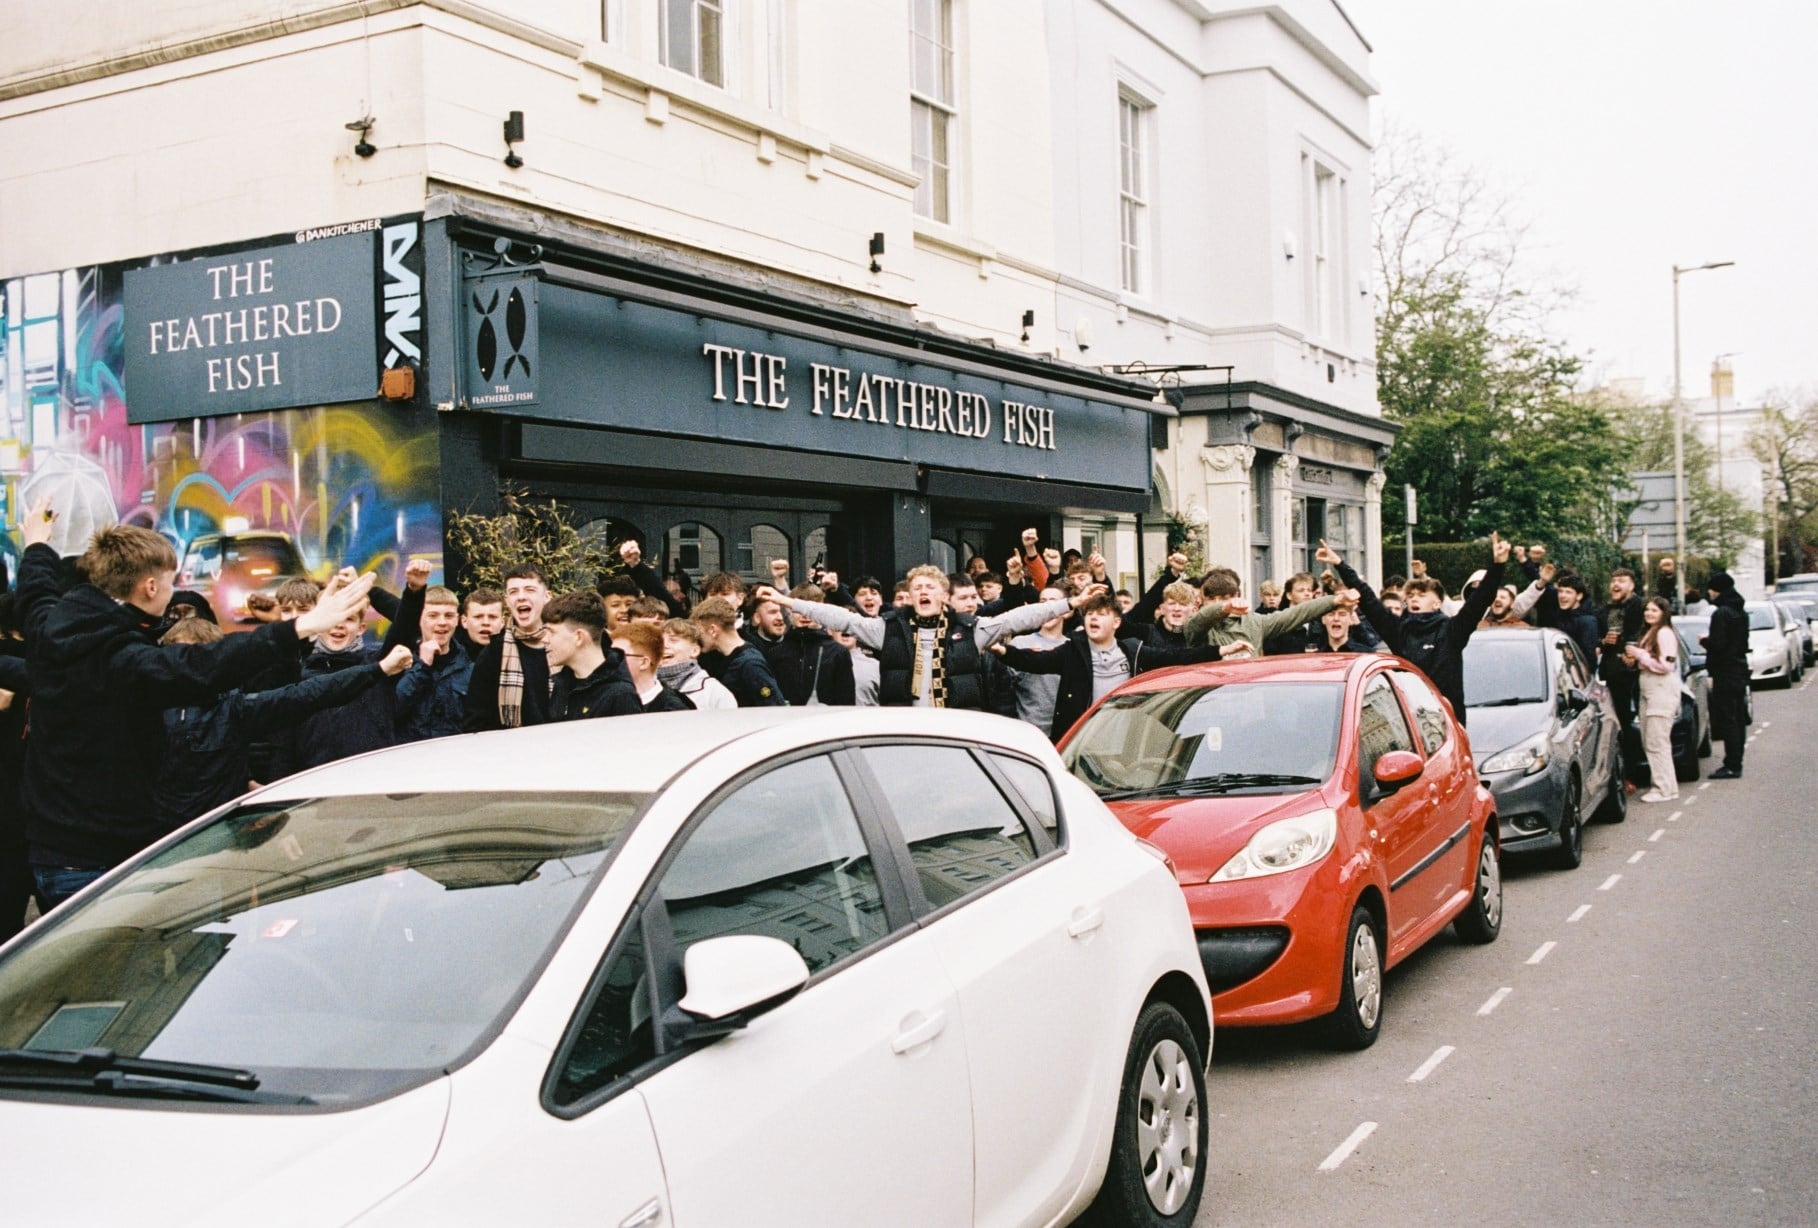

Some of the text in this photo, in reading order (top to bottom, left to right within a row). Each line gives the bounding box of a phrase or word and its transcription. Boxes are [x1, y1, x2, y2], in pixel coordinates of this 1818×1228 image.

[295, 218, 382, 244] @DANKITCHENER
[206, 258, 275, 301] THE
[148, 296, 342, 355] FEATHERED
[206, 351, 282, 394] FISH
[494, 384, 510, 393] THE
[472, 391, 533, 405] FEATHERED FISH
[703, 343, 1057, 450] THE FEATHERED FISH
